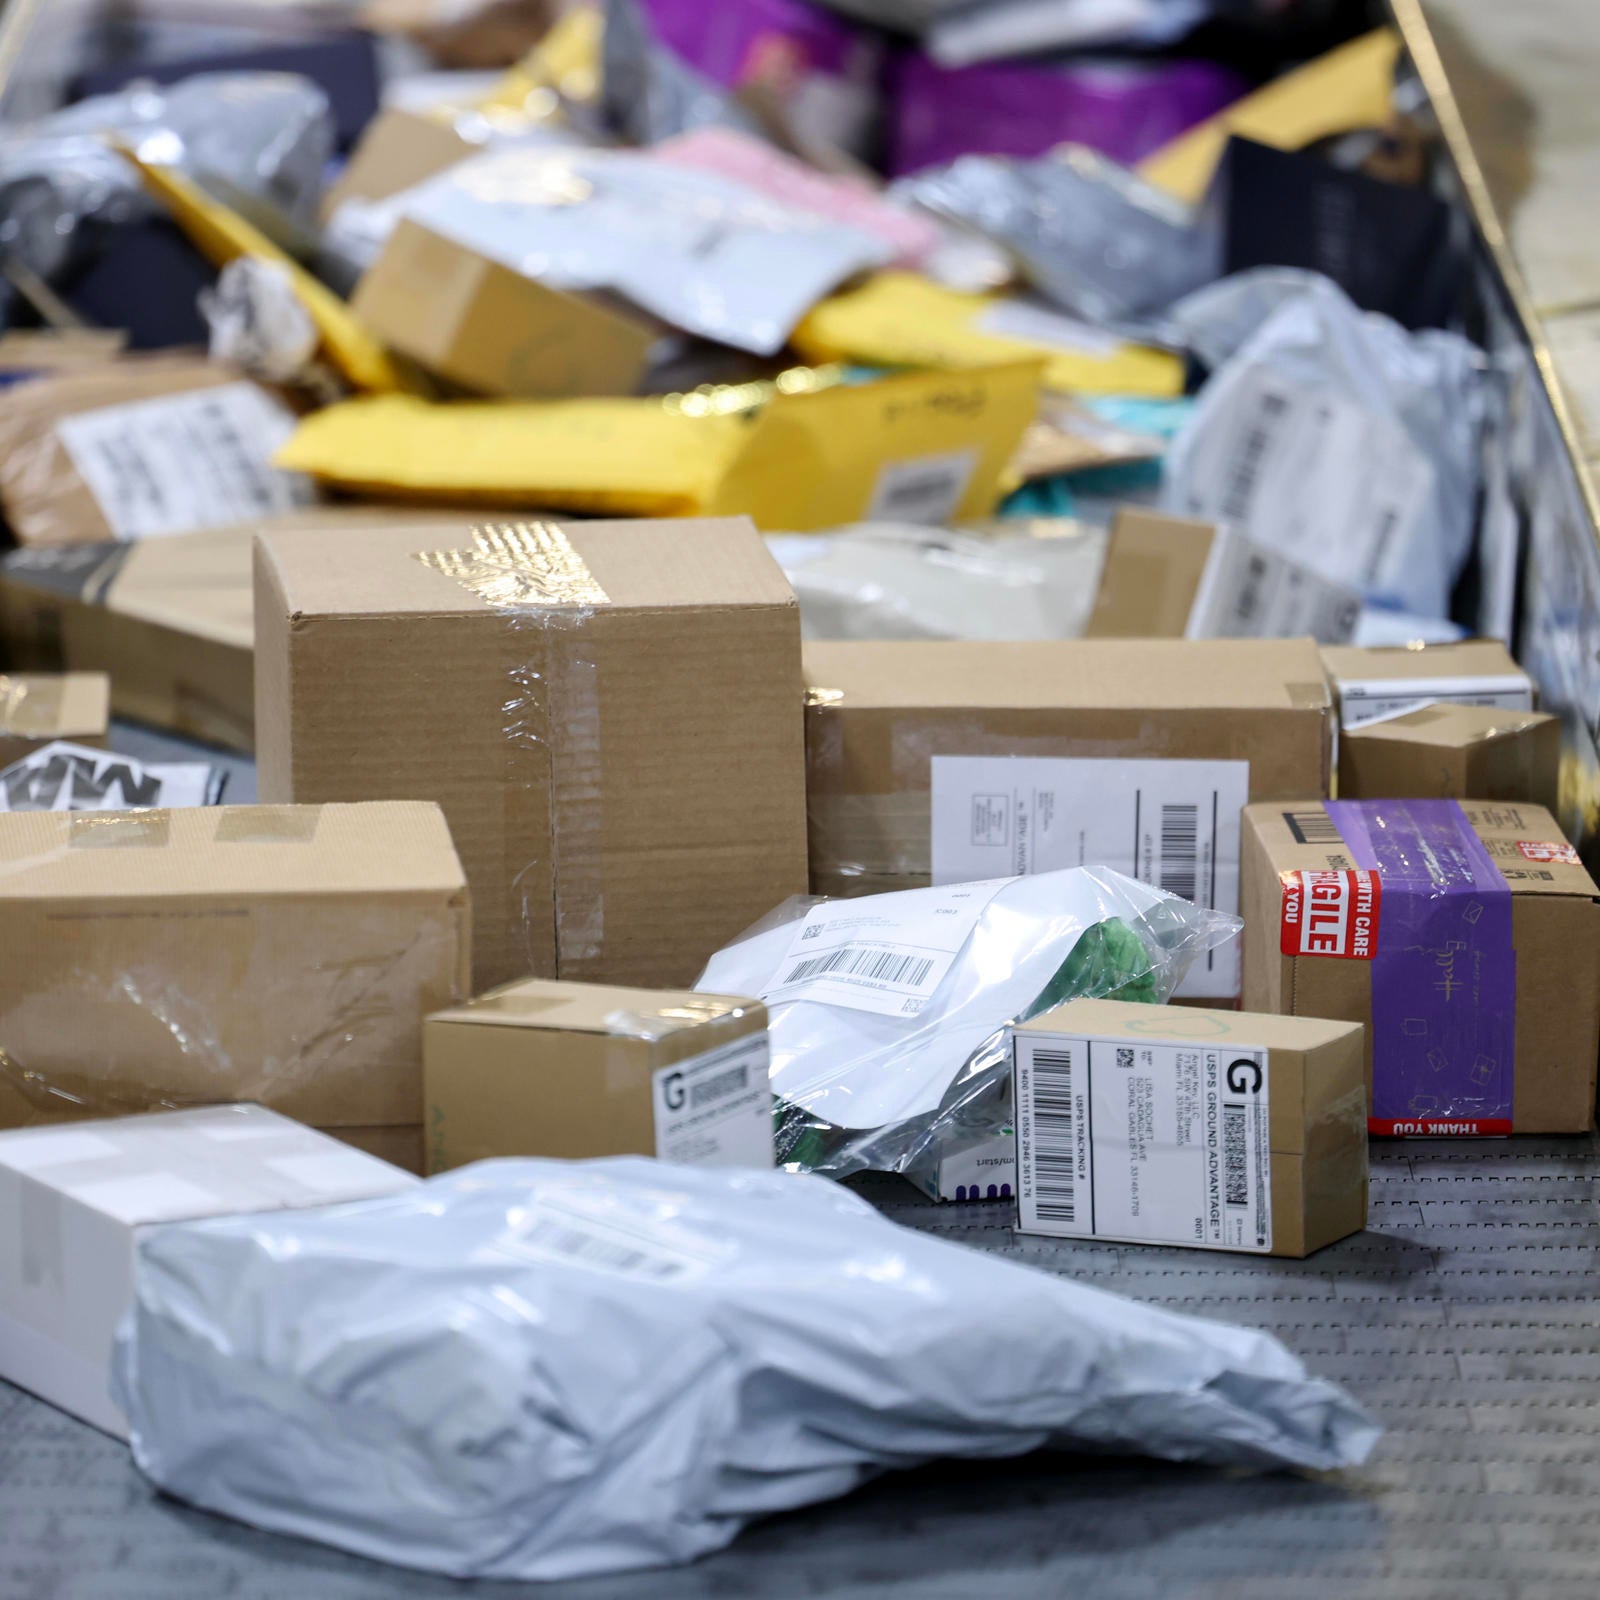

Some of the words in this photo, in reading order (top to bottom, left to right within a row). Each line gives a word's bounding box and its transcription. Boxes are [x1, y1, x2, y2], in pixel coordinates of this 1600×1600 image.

[1285, 893, 1300, 924] YOU
[1353, 916, 1371, 957] CARE
[1021, 1069, 1030, 1091] 9400
[1206, 1053, 1218, 1088] USPS
[1226, 1058, 1263, 1095] G
[663, 1072, 686, 1111] G
[1128, 1076, 1137, 1108] CORAL
[1144, 1077, 1153, 1098] LISA
[1022, 1093, 1030, 1114] 1111
[1076, 1095, 1085, 1121] USPS
[1022, 1116, 1030, 1138] 0550
[1128, 1111, 1138, 1150] GABLES
[1207, 1091, 1218, 1148] GROUND
[1392, 1122, 1424, 1136] YOU
[1427, 1122, 1480, 1135] THANK
[1077, 1122, 1086, 1171] TRACKING
[1138, 1144, 1148, 1162] AVE
[975, 1156, 1015, 1167] m/start
[1024, 1186, 1032, 1198] 76
